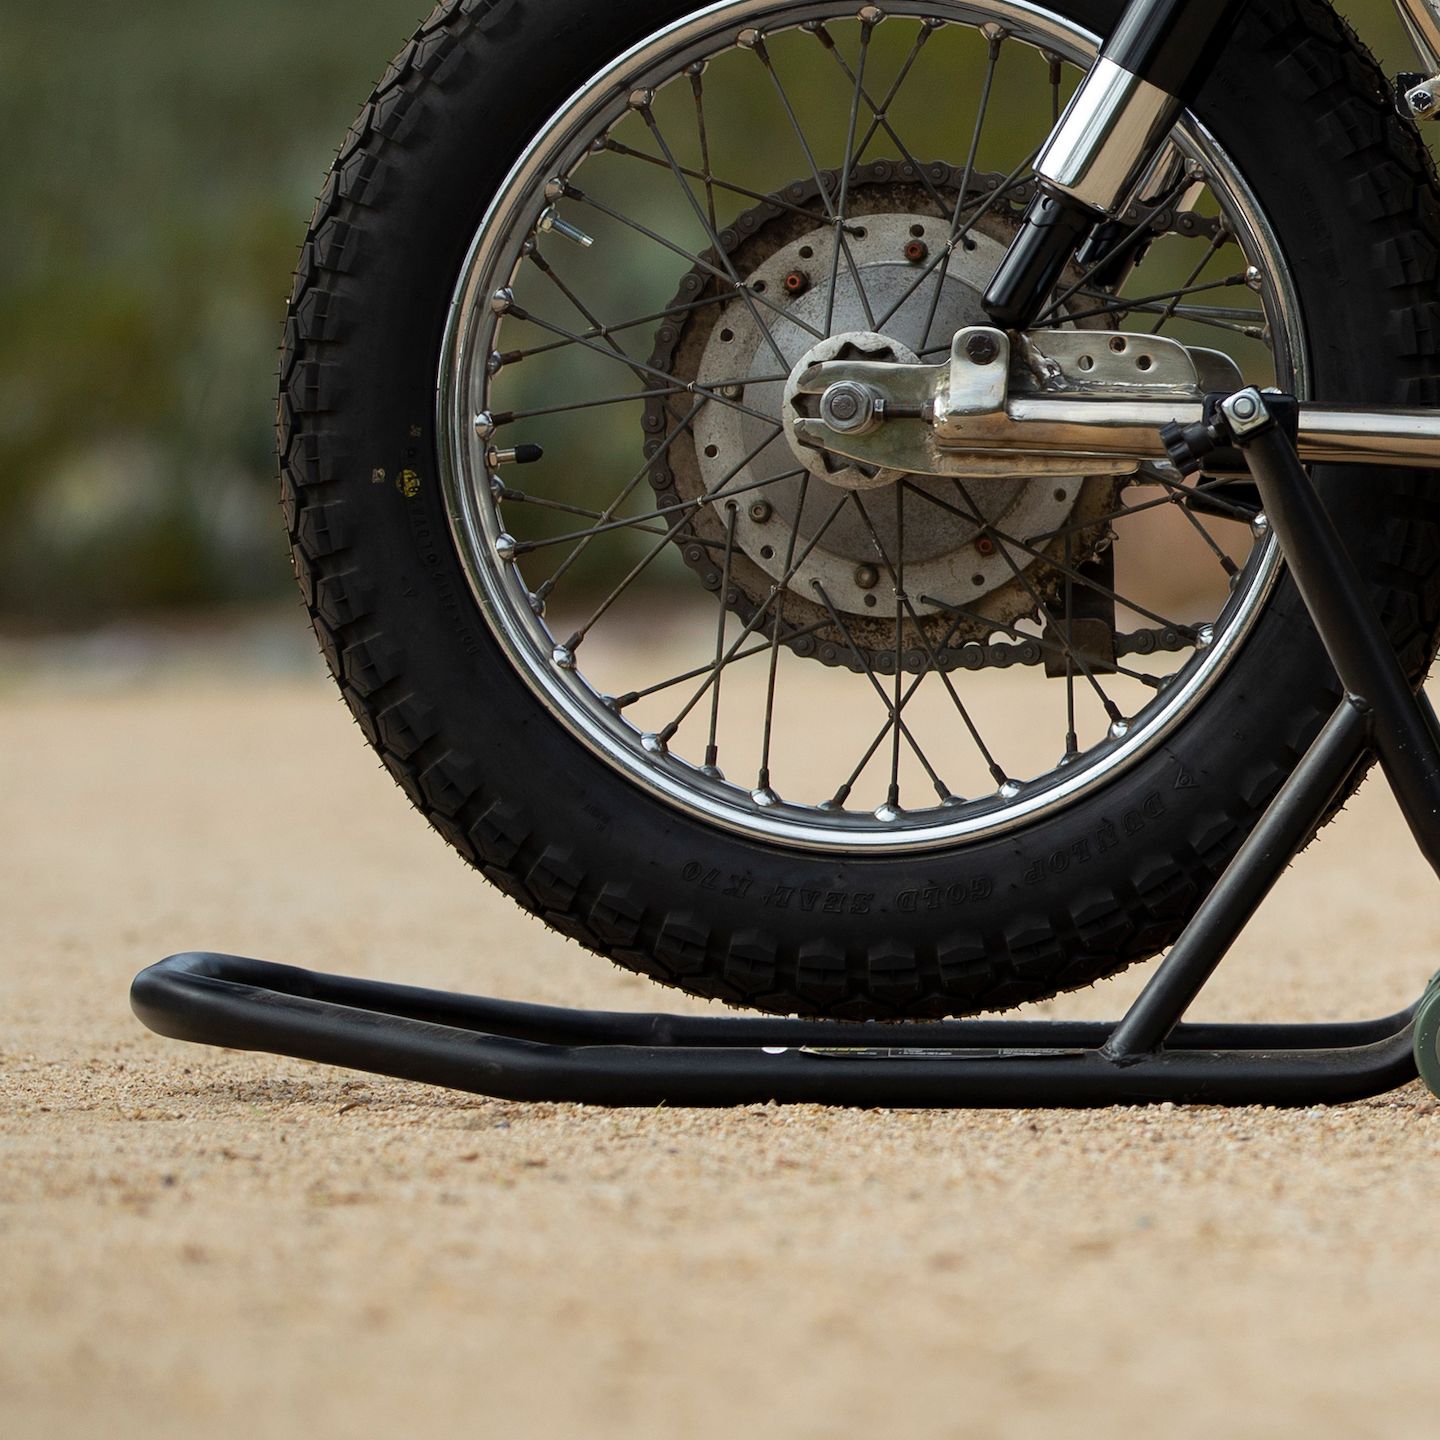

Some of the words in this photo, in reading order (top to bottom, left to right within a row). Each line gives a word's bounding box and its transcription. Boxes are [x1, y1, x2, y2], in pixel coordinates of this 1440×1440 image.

[1023, 791, 1168, 883] DUNLOP
[678, 857, 754, 901] K70
[770, 882, 875, 915] SEAL
[895, 875, 996, 913] GOLD
